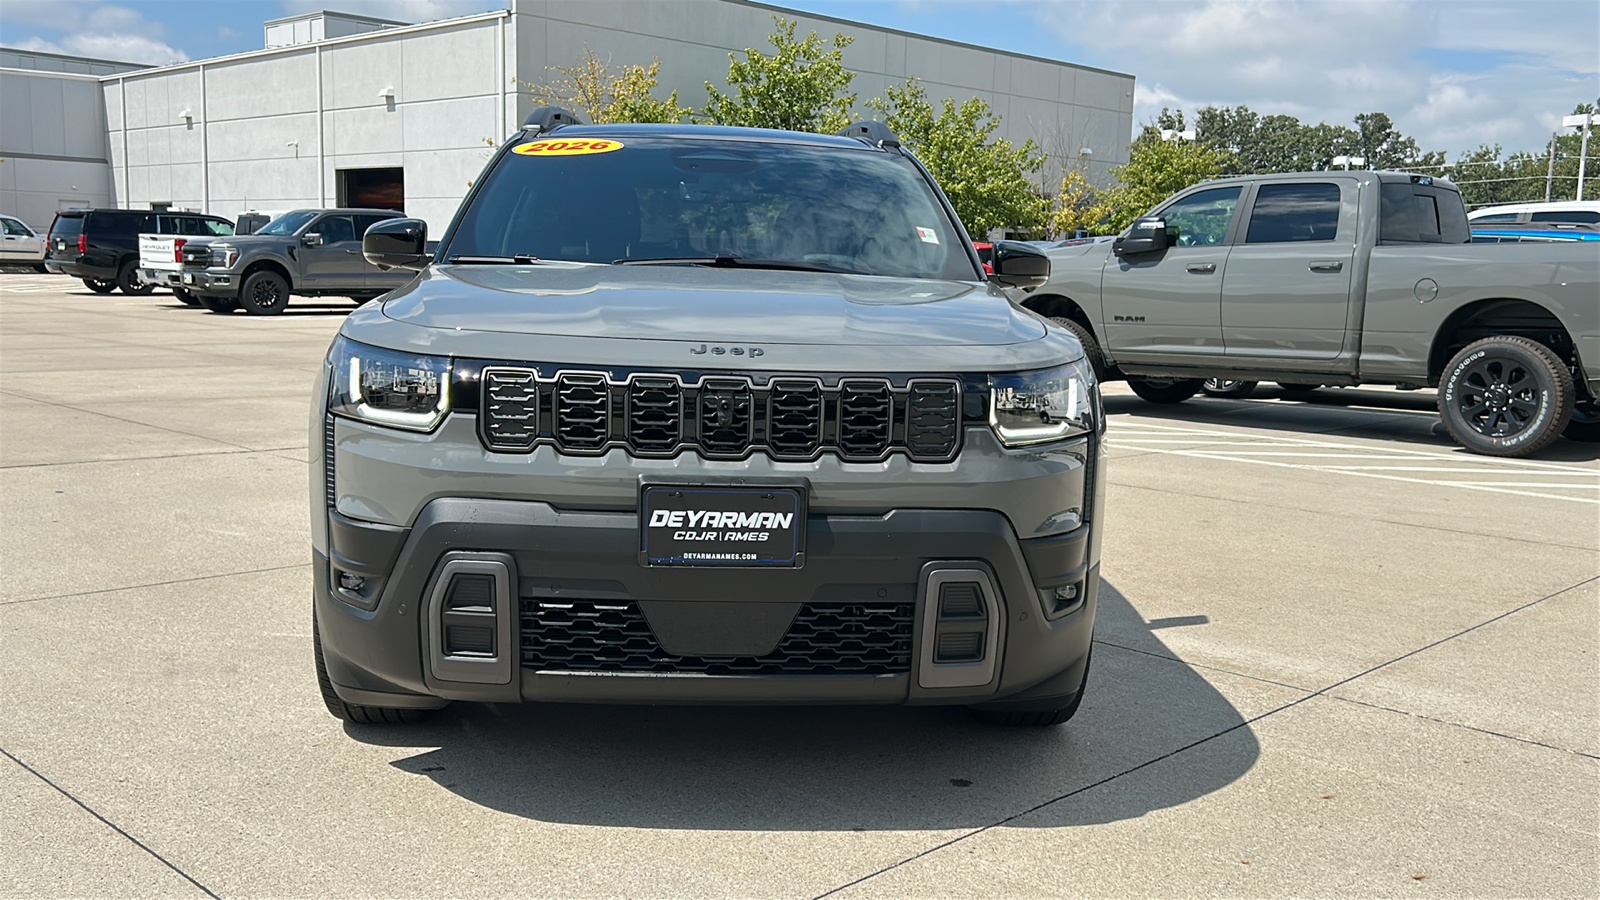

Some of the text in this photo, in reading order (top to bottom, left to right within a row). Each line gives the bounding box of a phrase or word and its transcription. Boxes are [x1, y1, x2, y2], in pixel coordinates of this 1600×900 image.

[523, 141, 612, 152] 2026
[689, 344, 765, 358] Jeep
[649, 509, 794, 530] DEYARMAN
[673, 531, 770, 542] CDJR AMES
[683, 552, 757, 560] DEYARMANAMES.COM
